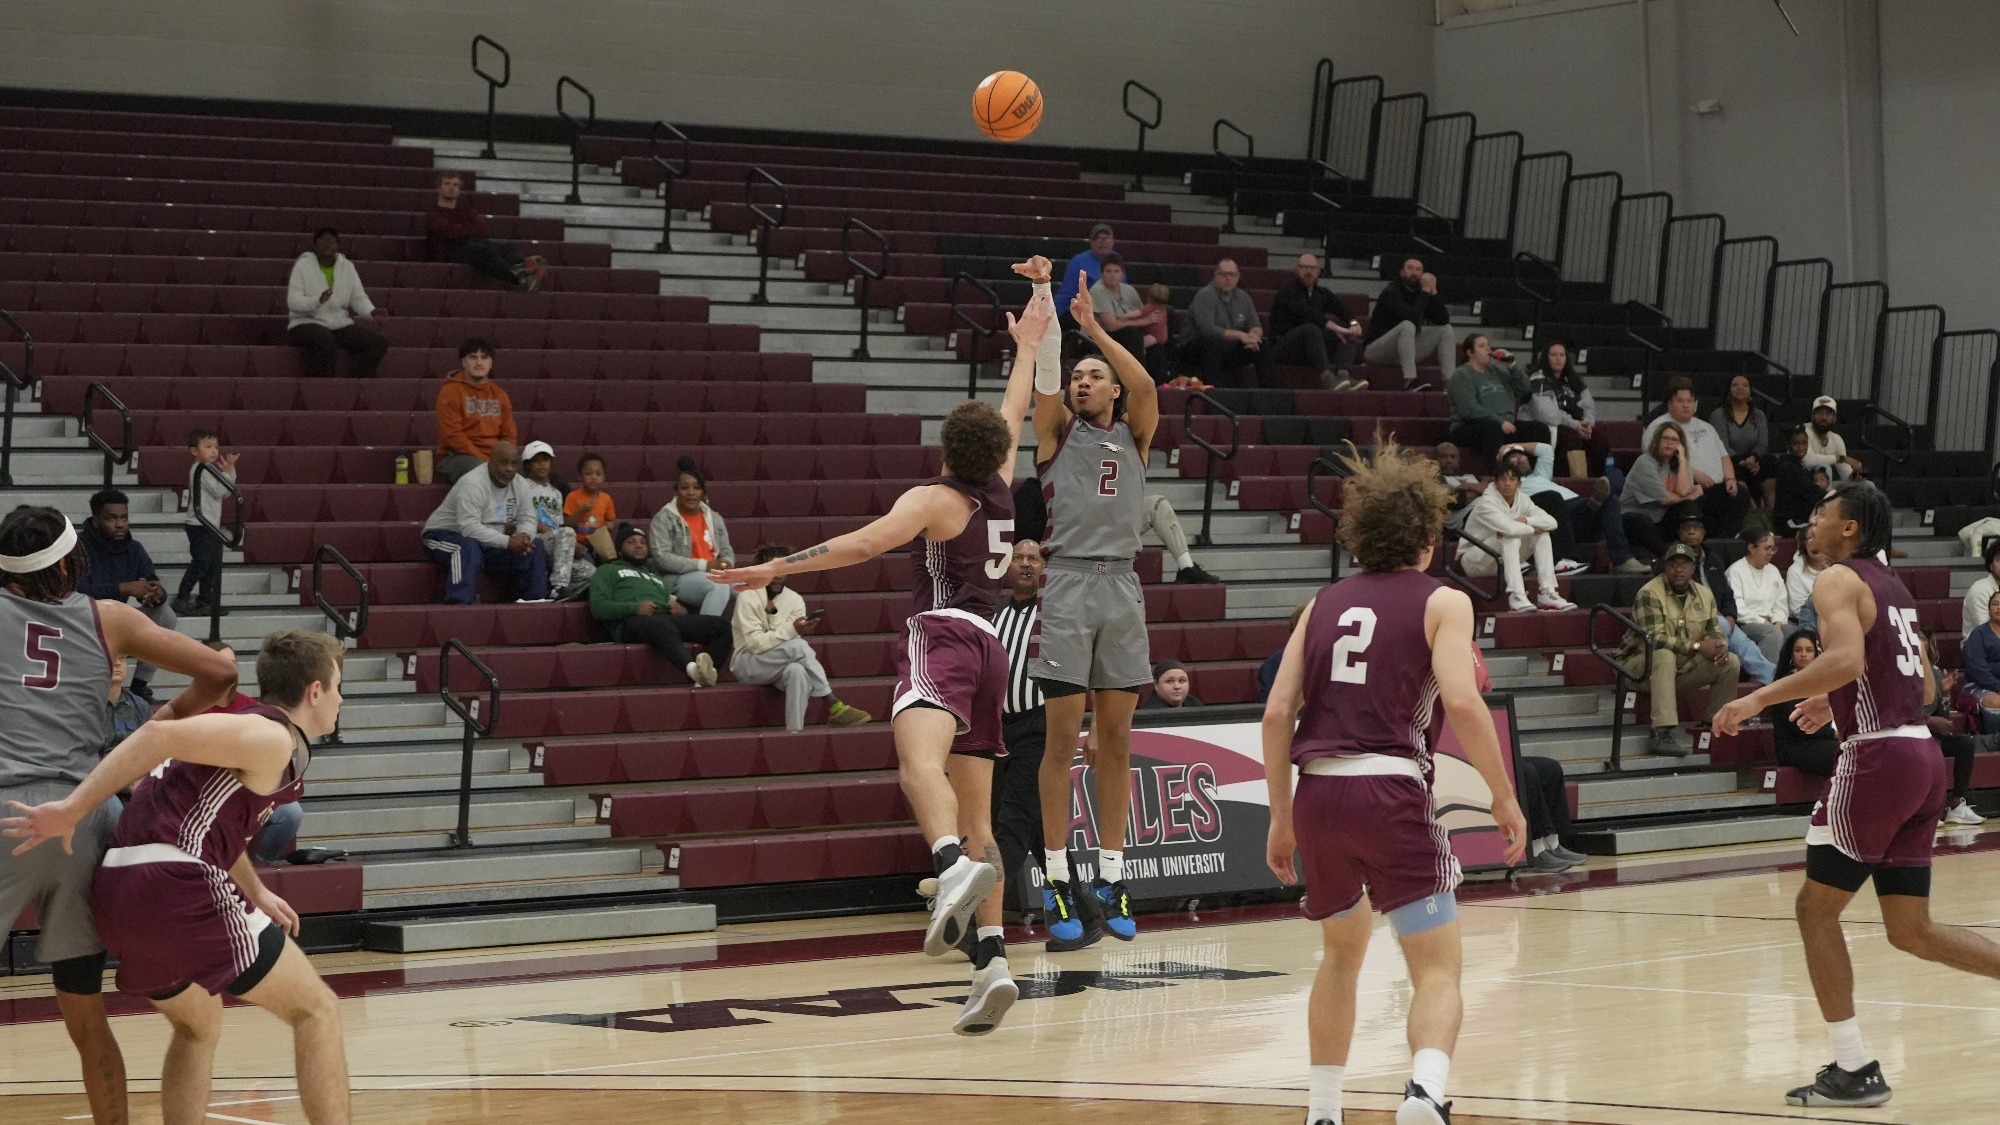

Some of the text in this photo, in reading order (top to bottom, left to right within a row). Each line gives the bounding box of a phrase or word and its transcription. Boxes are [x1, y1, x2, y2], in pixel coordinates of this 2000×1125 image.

[1098, 460, 1119, 496] 2
[984, 519, 1015, 580] 5
[22, 620, 63, 691] 5
[1330, 606, 1378, 685] 2
[1888, 605, 1925, 678] 35
[1028, 762, 1223, 854] ALES
[1120, 858, 1159, 880] ISTIAN
[1161, 852, 1225, 877] UNIVERSITY
